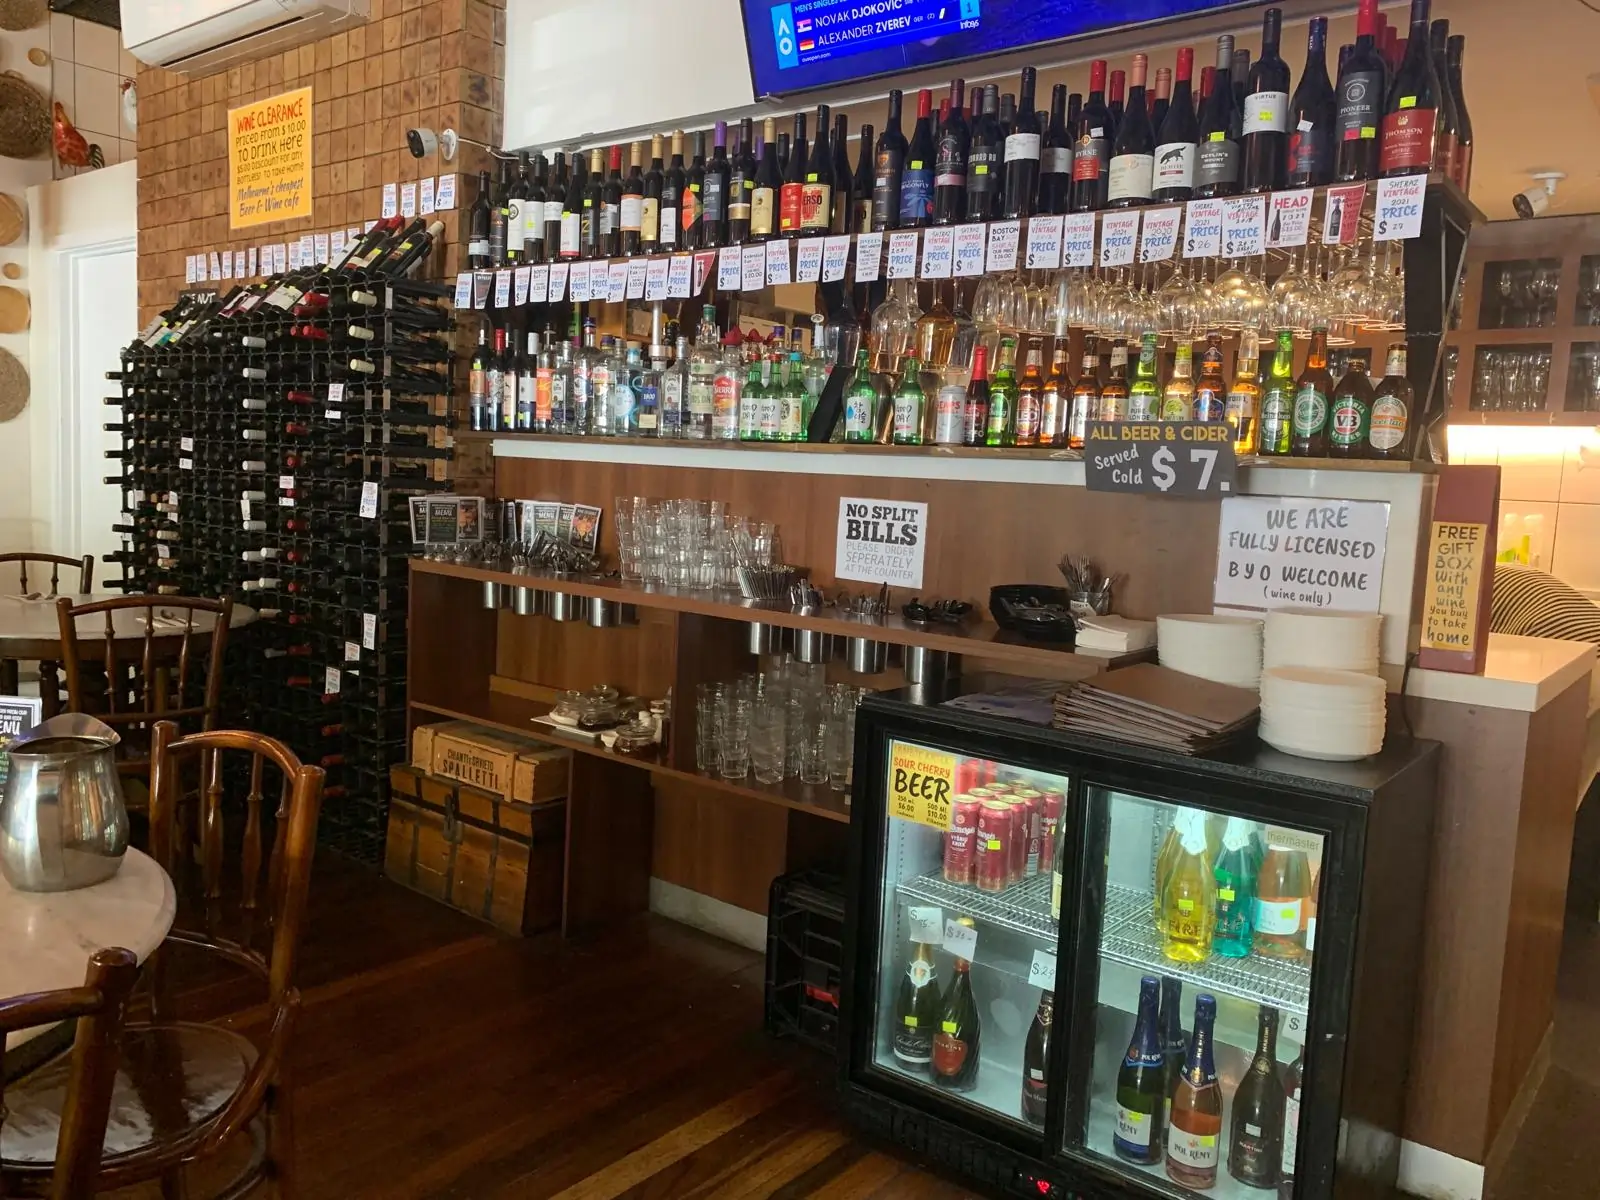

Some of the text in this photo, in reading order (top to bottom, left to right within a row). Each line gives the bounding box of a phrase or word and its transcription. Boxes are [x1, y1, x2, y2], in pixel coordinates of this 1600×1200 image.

[815, 10, 850, 28] NOVAK
[818, 24, 874, 47] ALEXANDER
[875, 16, 911, 34] ZVEREV
[237, 97, 304, 134] WINE CLEARANCE
[1385, 127, 1424, 140] THOMSON
[237, 148, 249, 162] TO
[1383, 186, 1420, 198] VINTAGE
[1274, 194, 1309, 210] HEAD
[1190, 208, 1221, 219] VINTAGE
[1381, 204, 1419, 220] PRICE
[992, 226, 1019, 235] BOSTON
[1031, 225, 1058, 234] VINTAGE
[1066, 225, 1093, 233] VINTAGE
[1106, 219, 1134, 230] VINTAGE
[1145, 219, 1175, 230] VINTAGE
[1190, 225, 1220, 238] PRICE
[1378, 220, 1388, 236] $
[1227, 226, 1260, 240] PRICE
[1030, 241, 1057, 252] PRICE
[1066, 240, 1092, 251] PRICE
[1105, 235, 1133, 248] PRICE
[1144, 234, 1173, 248] PRICE
[890, 254, 913, 265] PRICE
[927, 251, 950, 261] PRICE
[958, 248, 982, 259] PRICE
[768, 262, 789, 273] PRICE
[800, 259, 818, 269] PRICE
[826, 258, 845, 269] PRICE
[721, 266, 740, 277] PRICE
[1017, 409, 1038, 420] LEO
[1336, 415, 1358, 427] VB
[1090, 425, 1229, 442] ALL BEER & CIDER
[1094, 443, 1140, 470] Served
[1151, 445, 1176, 492] $
[1112, 467, 1143, 485] Cold
[846, 503, 919, 523] NO SPLIT
[1266, 506, 1350, 530] WE ARE
[845, 518, 919, 547] BILLS
[1437, 525, 1480, 541] FREE
[846, 541, 916, 557] PLEASE ORDER
[1229, 530, 1376, 560] FULLY LICENSED
[1438, 541, 1475, 556] GIFT
[845, 551, 914, 569] SEPERATELY
[1434, 555, 1475, 571] BOX
[844, 563, 914, 580] AT THE COUNTER
[1282, 565, 1369, 591] WELCOME
[1437, 584, 1464, 600] any
[1435, 596, 1467, 610] wine
[1429, 605, 1469, 620] you buy
[1427, 616, 1467, 630] to take
[1426, 626, 1470, 646] home
[442, 759, 499, 790] SPALLETTI
[893, 756, 952, 779] SOUR CHERRY
[894, 768, 951, 805] BEER
[927, 809, 948, 821] $10.00
[1174, 1144, 1188, 1156] POL
